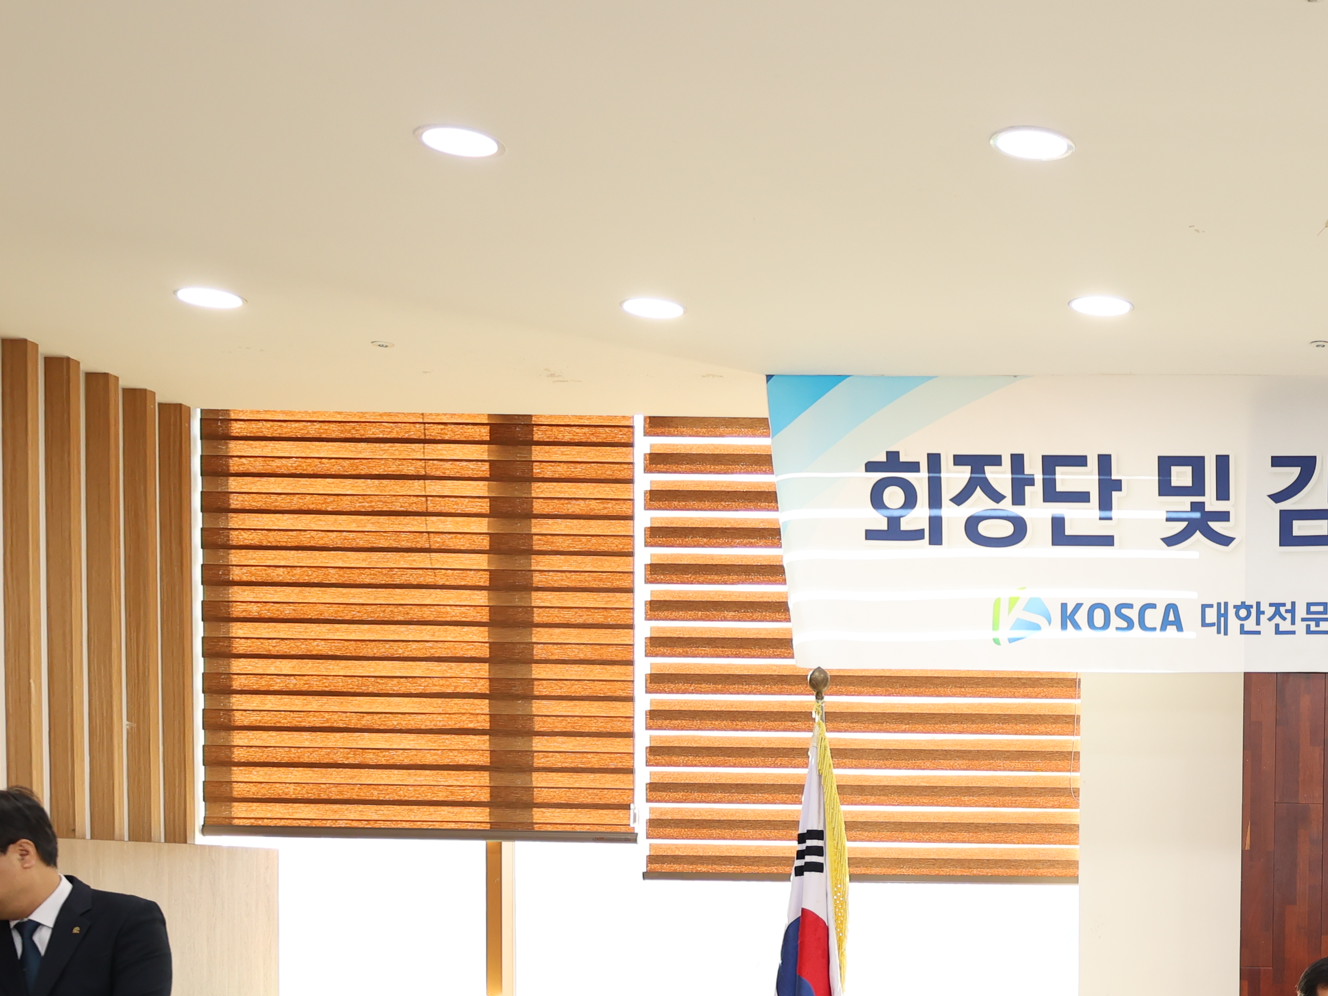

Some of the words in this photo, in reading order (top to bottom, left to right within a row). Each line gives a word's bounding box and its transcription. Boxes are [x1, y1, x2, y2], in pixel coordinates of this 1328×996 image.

[864, 450, 1124, 549] 회장단
[1157, 453, 1237, 548] 및
[1060, 602, 1184, 632] KOSCA
